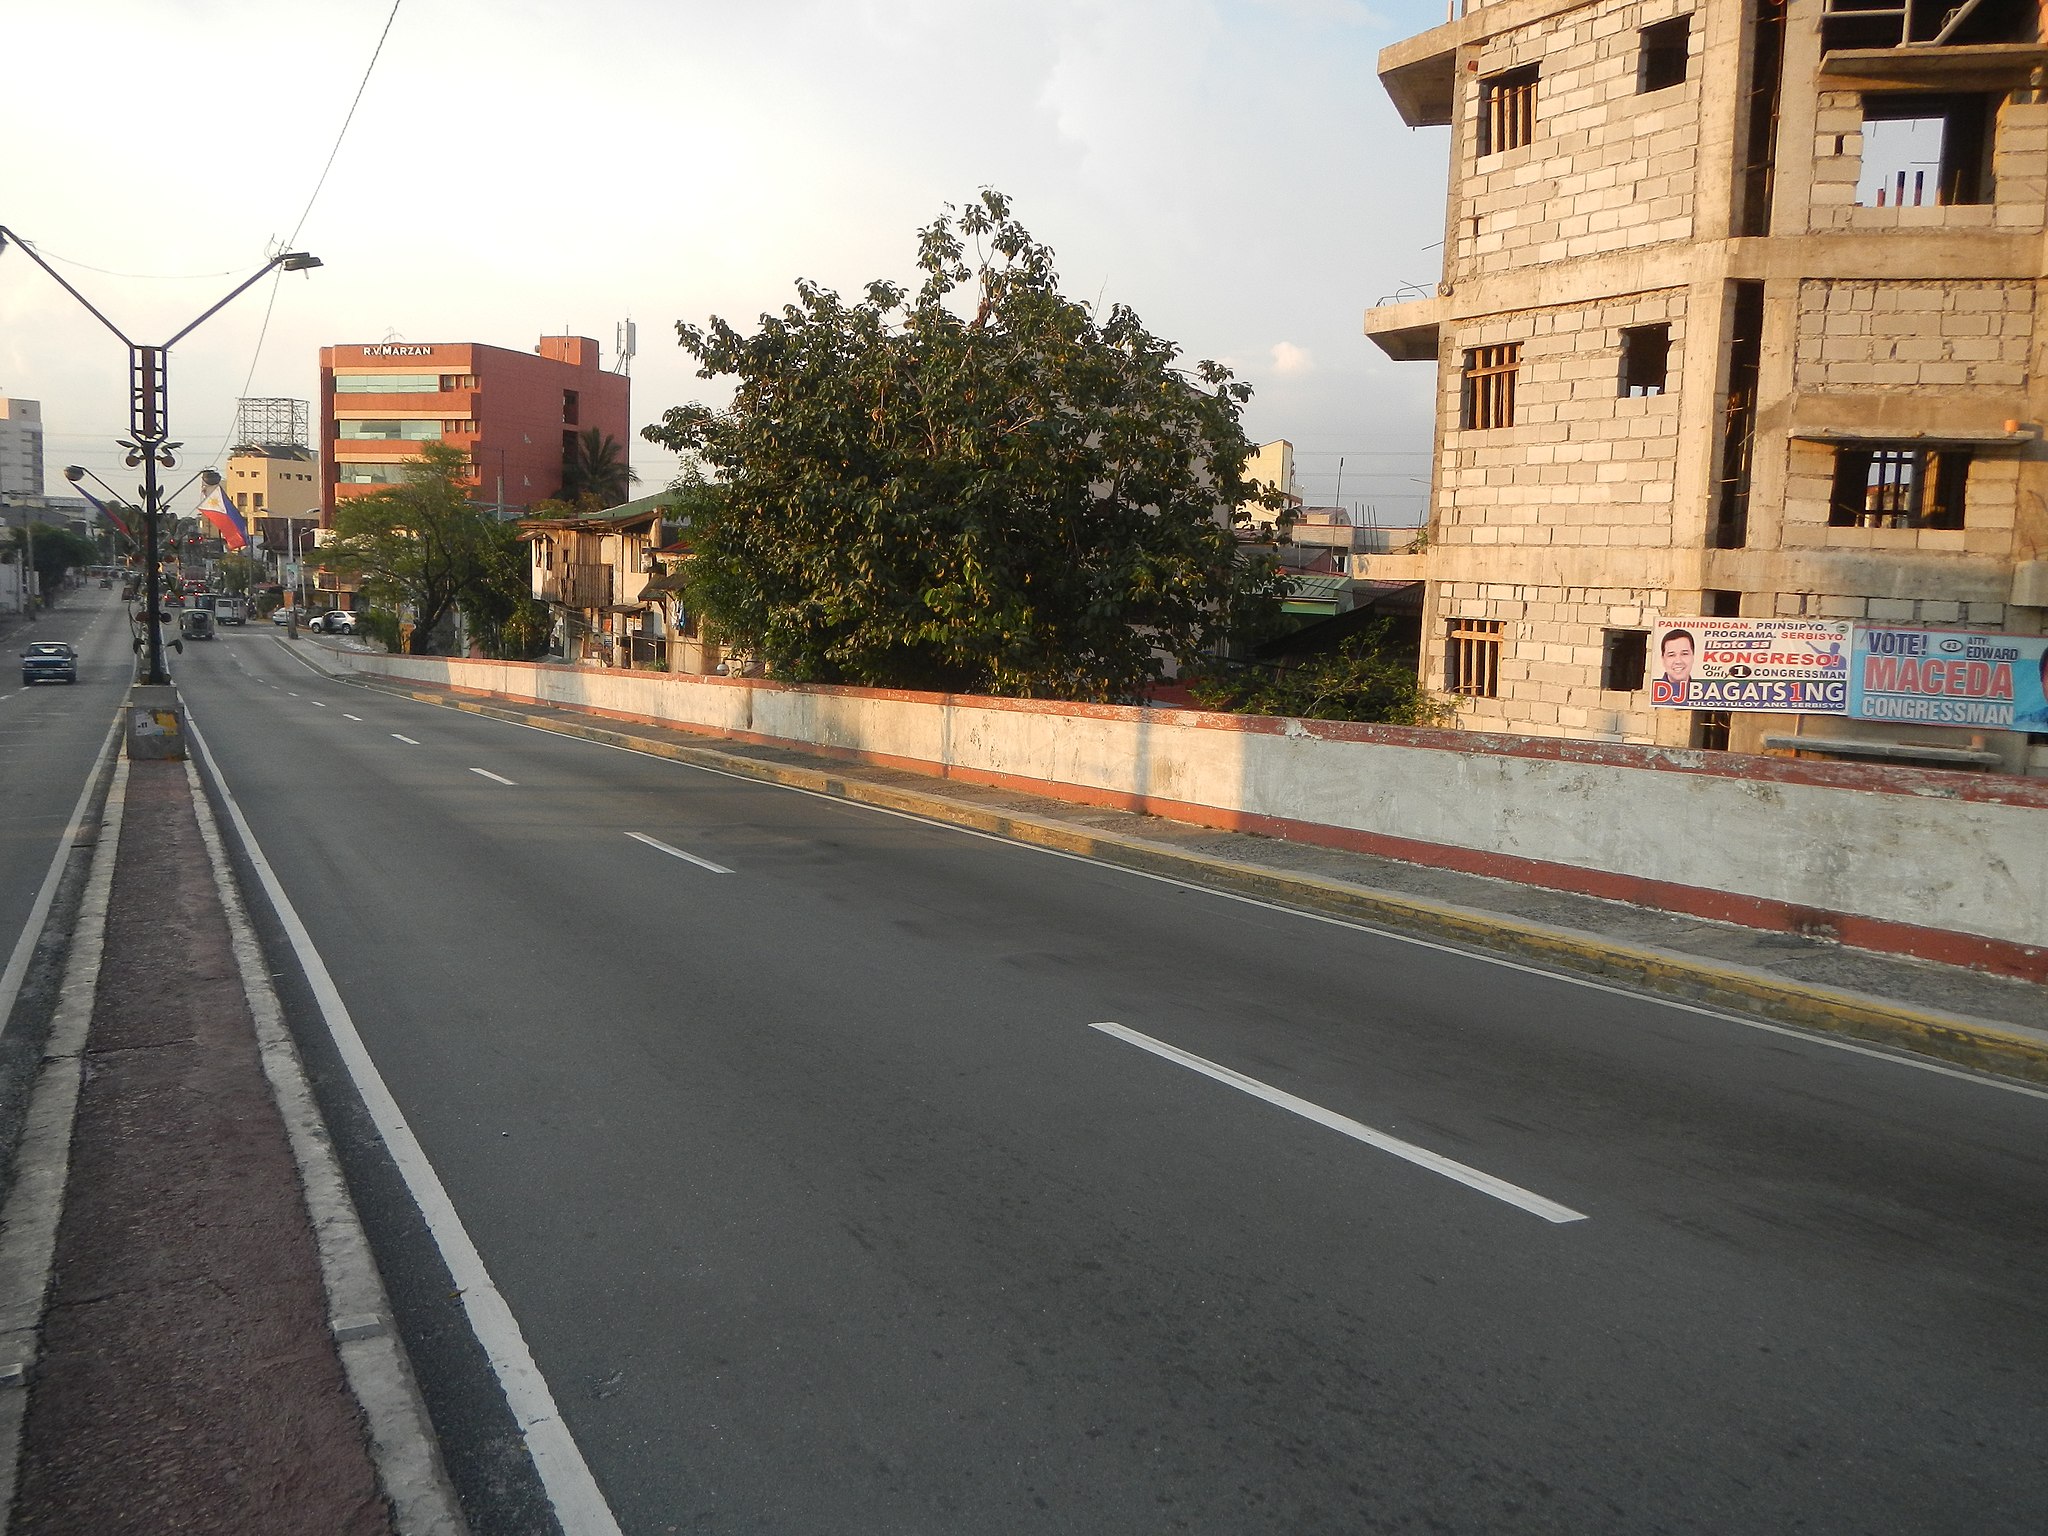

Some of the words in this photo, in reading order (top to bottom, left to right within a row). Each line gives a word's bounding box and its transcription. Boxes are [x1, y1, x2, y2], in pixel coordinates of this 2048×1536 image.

[382, 346, 431, 355] MARZAN
[1658, 621, 1751, 630] PANININDIGAN.
[1756, 622, 1827, 631] PRINSIPYO.
[1704, 630, 1776, 638] PROGRAMA.
[1781, 632, 1846, 640] SERBISYO.
[1706, 640, 1746, 649] Iboto
[1751, 641, 1768, 649] sa
[1868, 632, 1928, 655] VOTE!
[1703, 651, 1839, 667] KONGRESO!
[1966, 646, 2019, 660] EDWARD
[1705, 670, 1730, 679] Only
[1734, 666, 1747, 677] 1
[1754, 668, 1846, 679] CONGRESSMAN
[1863, 655, 2014, 699] MACEDA
[1652, 680, 1688, 703] DJ
[1687, 700, 1759, 708] TULOY-TULOY
[1861, 697, 2014, 726] CONGRESSMAN
